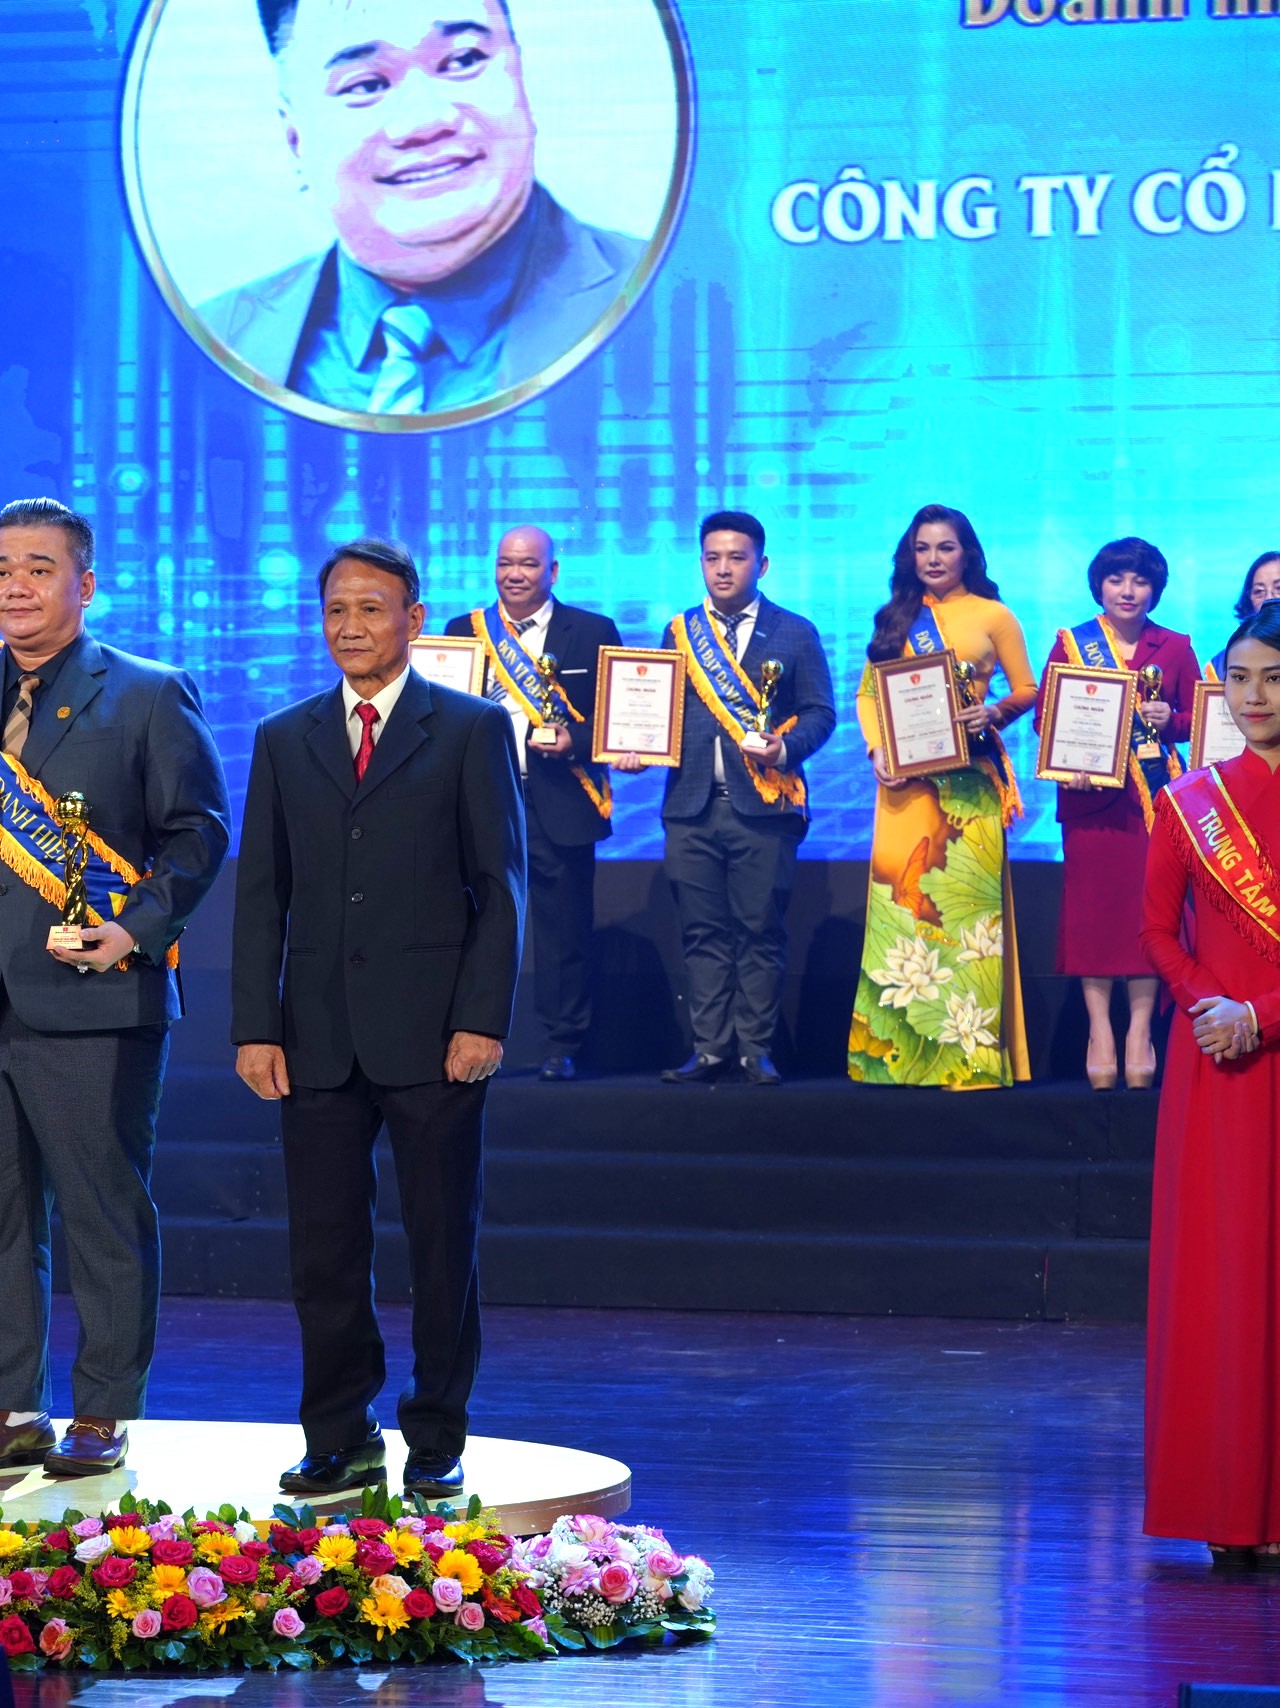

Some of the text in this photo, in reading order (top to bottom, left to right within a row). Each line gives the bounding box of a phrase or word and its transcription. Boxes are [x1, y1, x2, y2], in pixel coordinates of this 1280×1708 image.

[771, 166, 998, 244] CÔNG
[1019, 172, 1114, 238] TY
[1132, 143, 1246, 236] CỔ
[1197, 806, 1243, 871] TRUNG
[1234, 868, 1278, 918] TÂM
